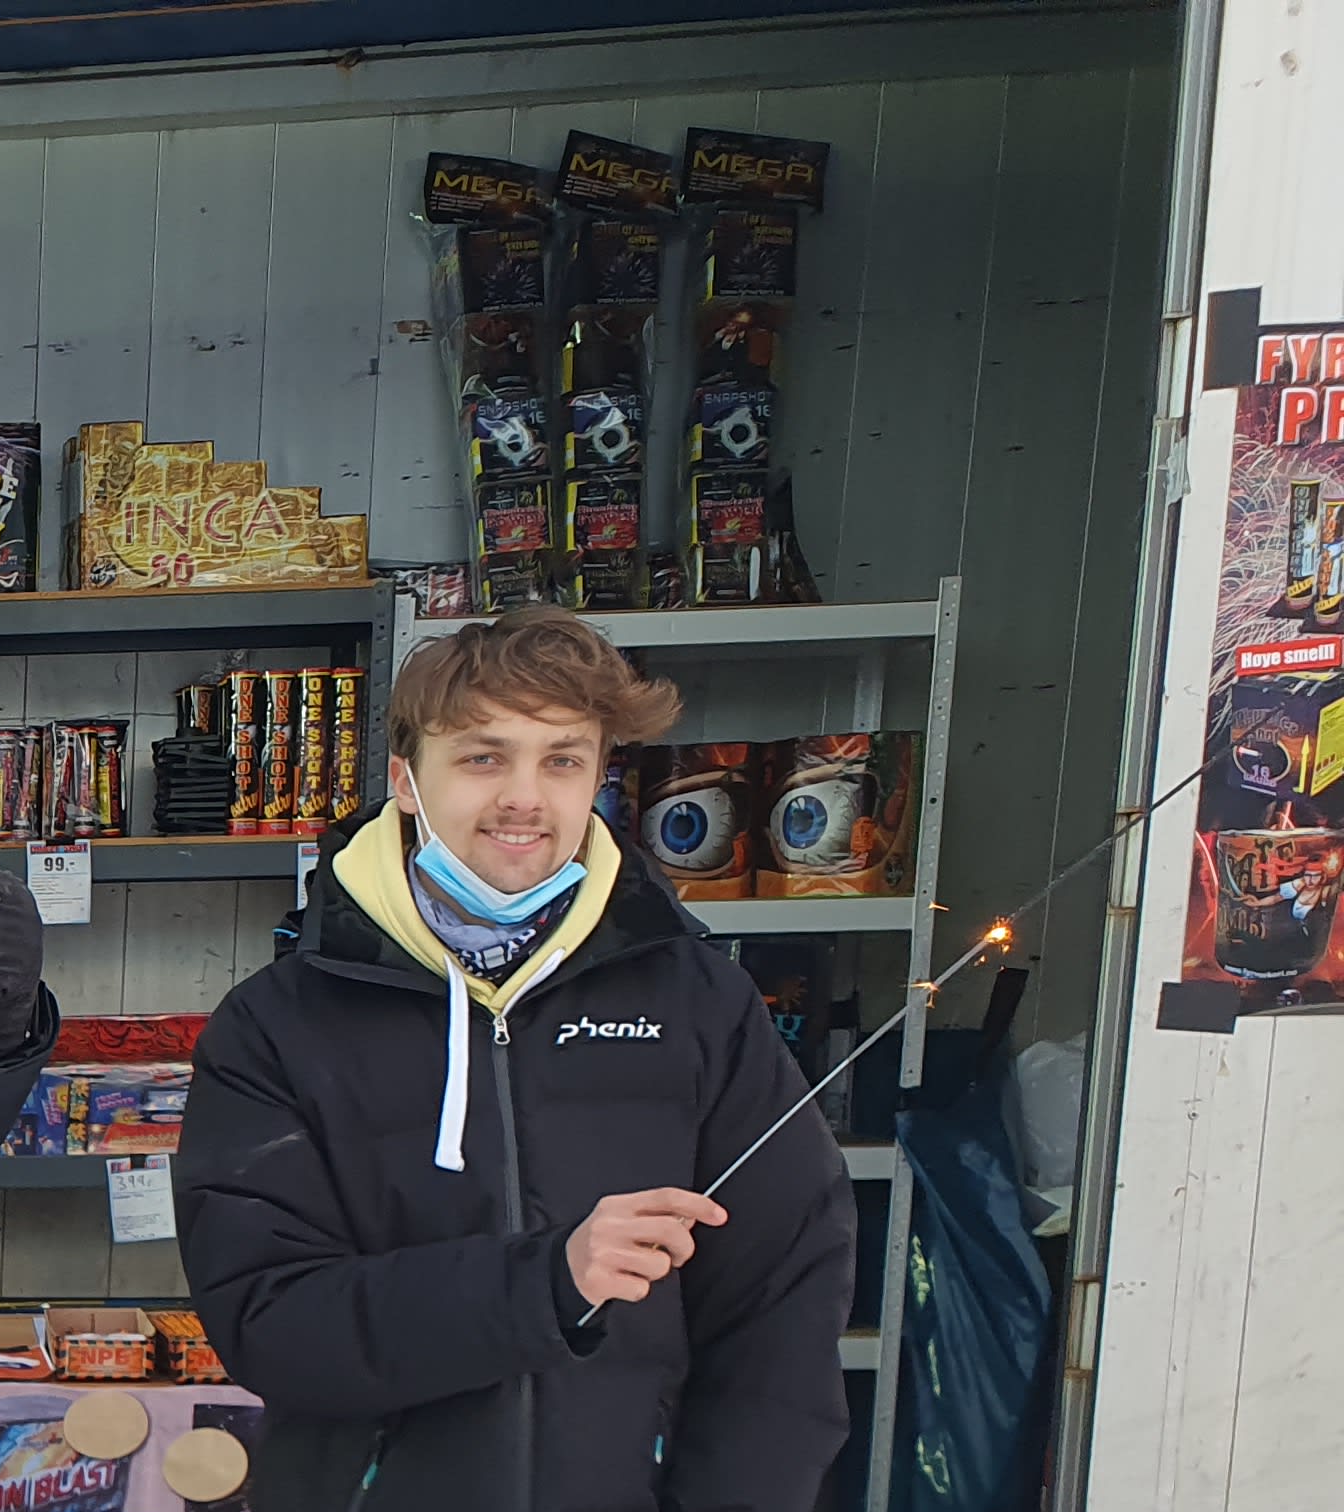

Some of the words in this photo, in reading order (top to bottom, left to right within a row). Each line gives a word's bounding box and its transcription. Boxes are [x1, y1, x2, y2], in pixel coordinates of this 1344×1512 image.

[693, 149, 815, 184] MEGA
[121, 488, 290, 549] INCA
[44, 856, 75, 872] 99,-
[555, 1016, 663, 1045] phenix
